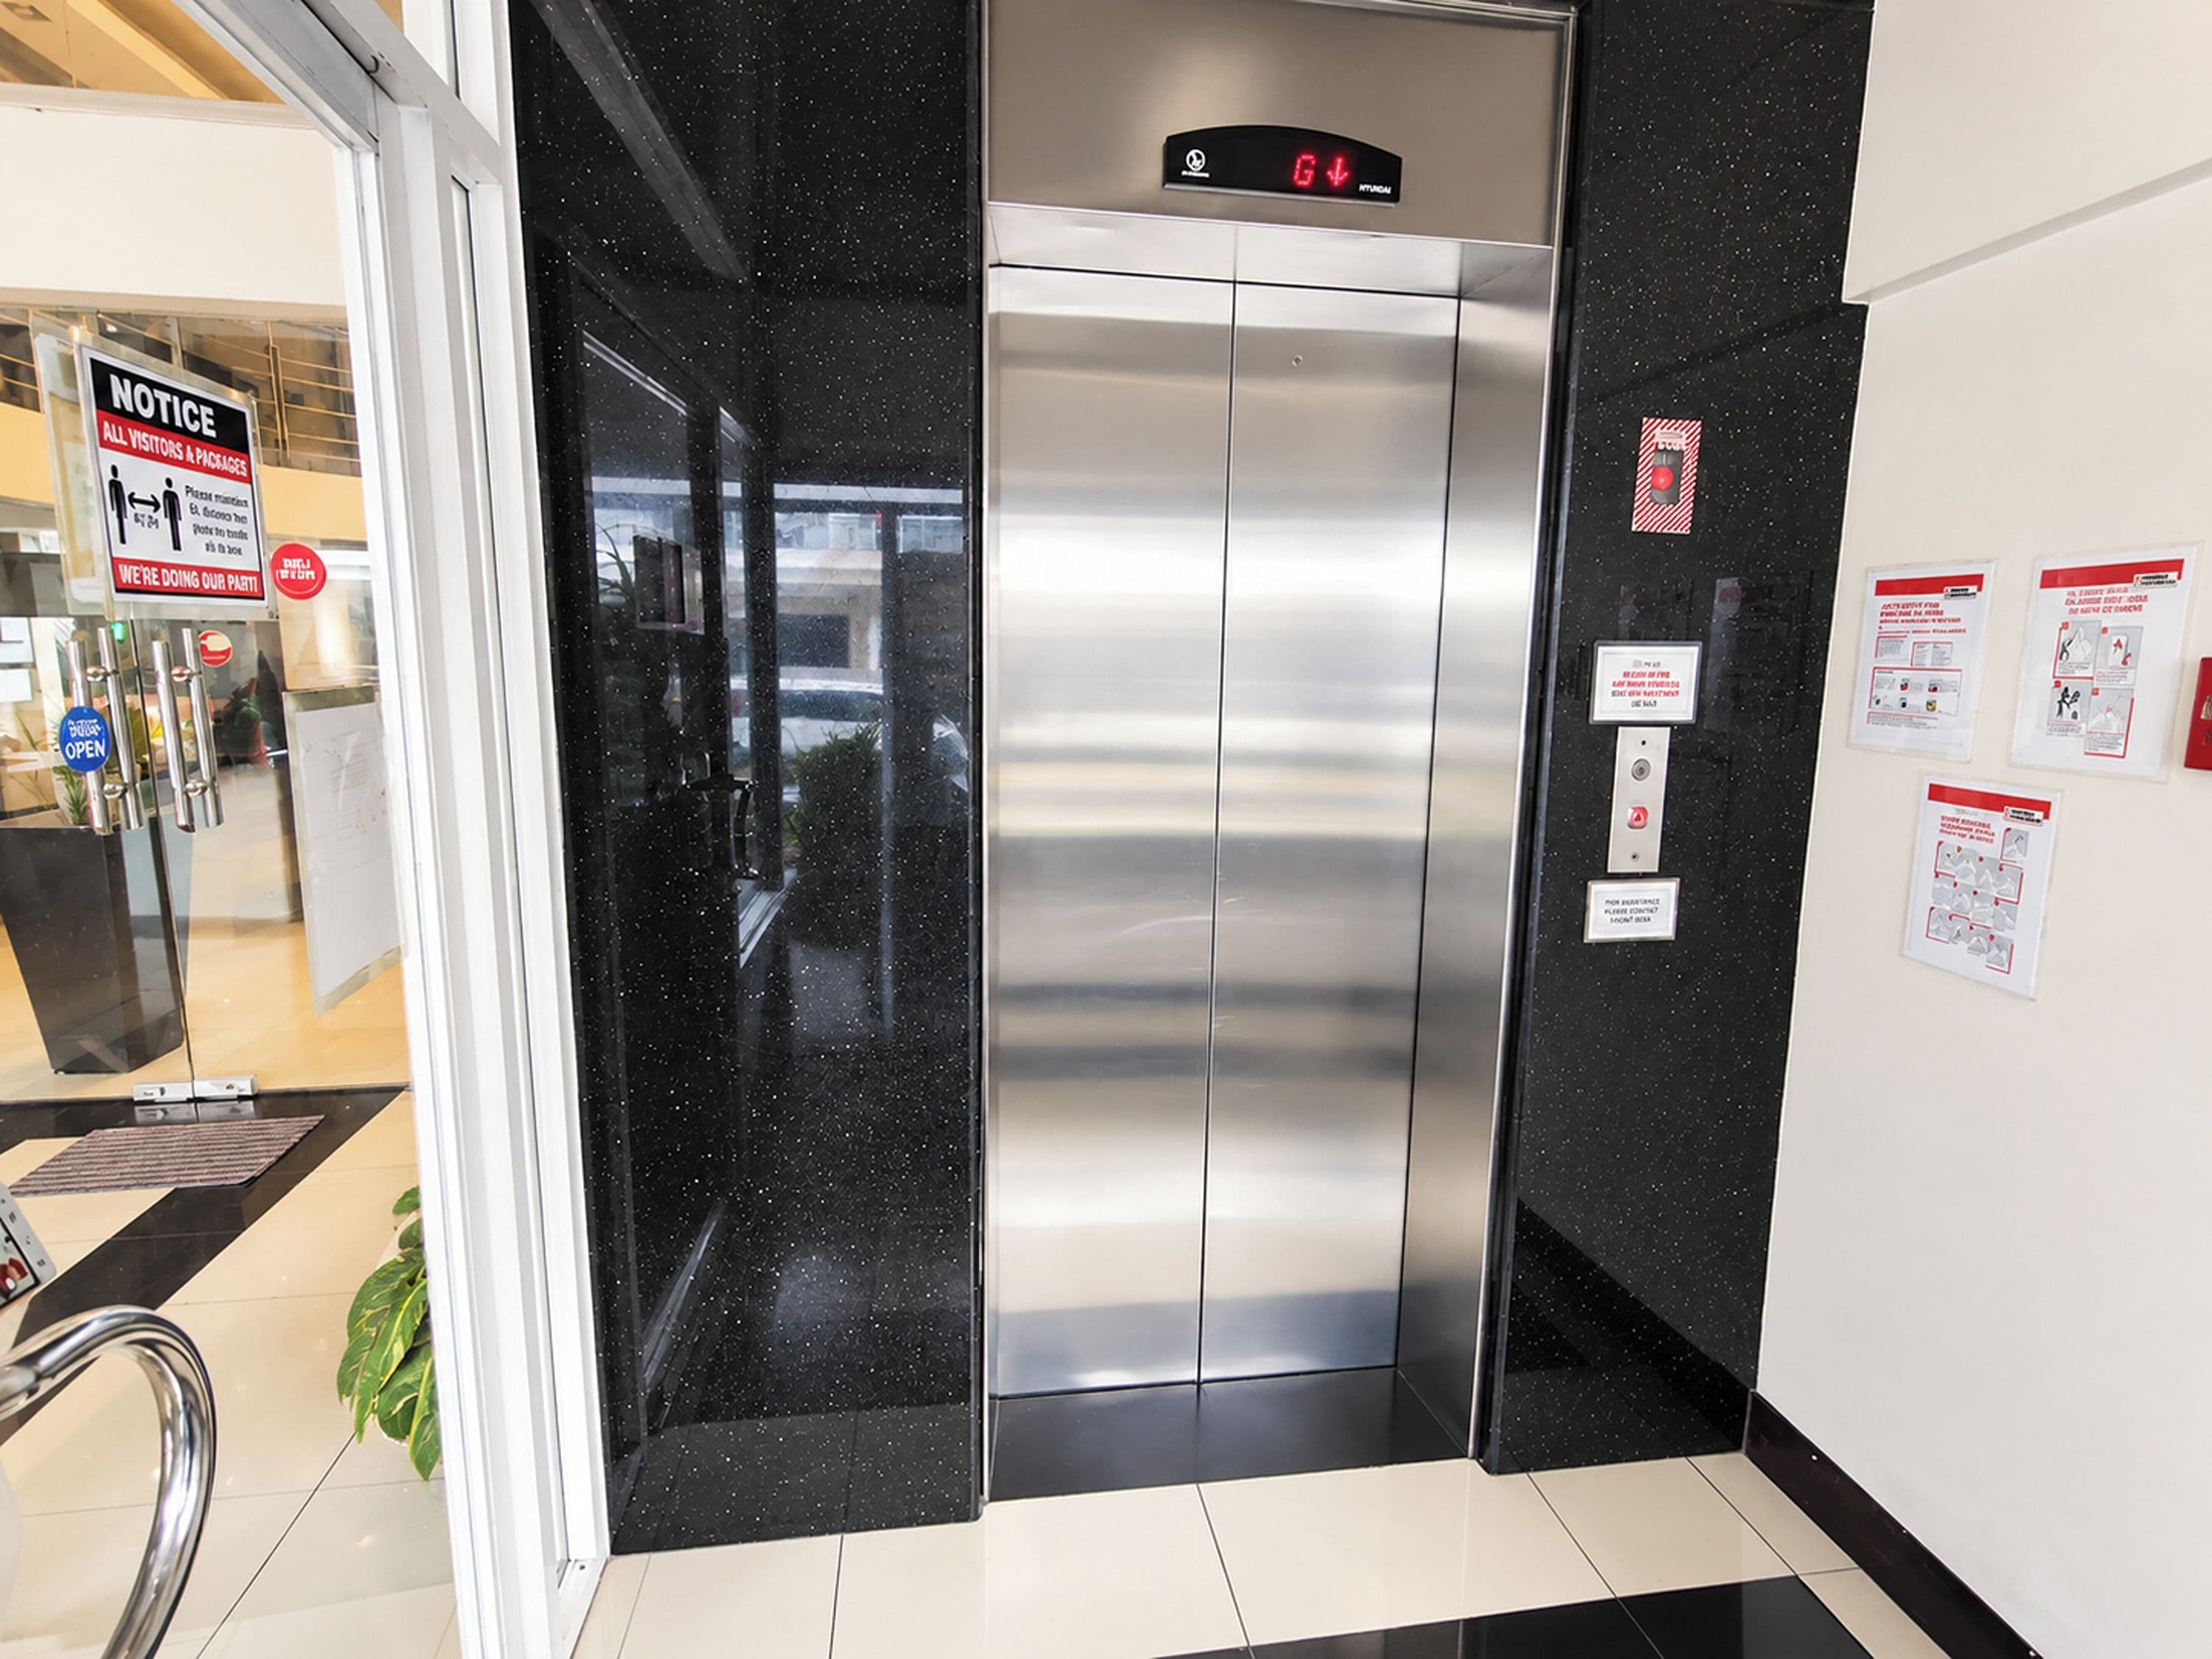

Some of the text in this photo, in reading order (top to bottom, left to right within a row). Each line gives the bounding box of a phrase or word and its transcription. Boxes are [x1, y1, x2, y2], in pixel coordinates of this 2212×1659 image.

[1294, 153, 1316, 187] G
[110, 373, 217, 438] NOTICE
[102, 420, 128, 446] ALL
[128, 428, 184, 461] VISITORS
[118, 563, 161, 586] WE'RE
[161, 568, 200, 588] DOING
[201, 573, 225, 591] OUR
[65, 738, 105, 760] OPEN
